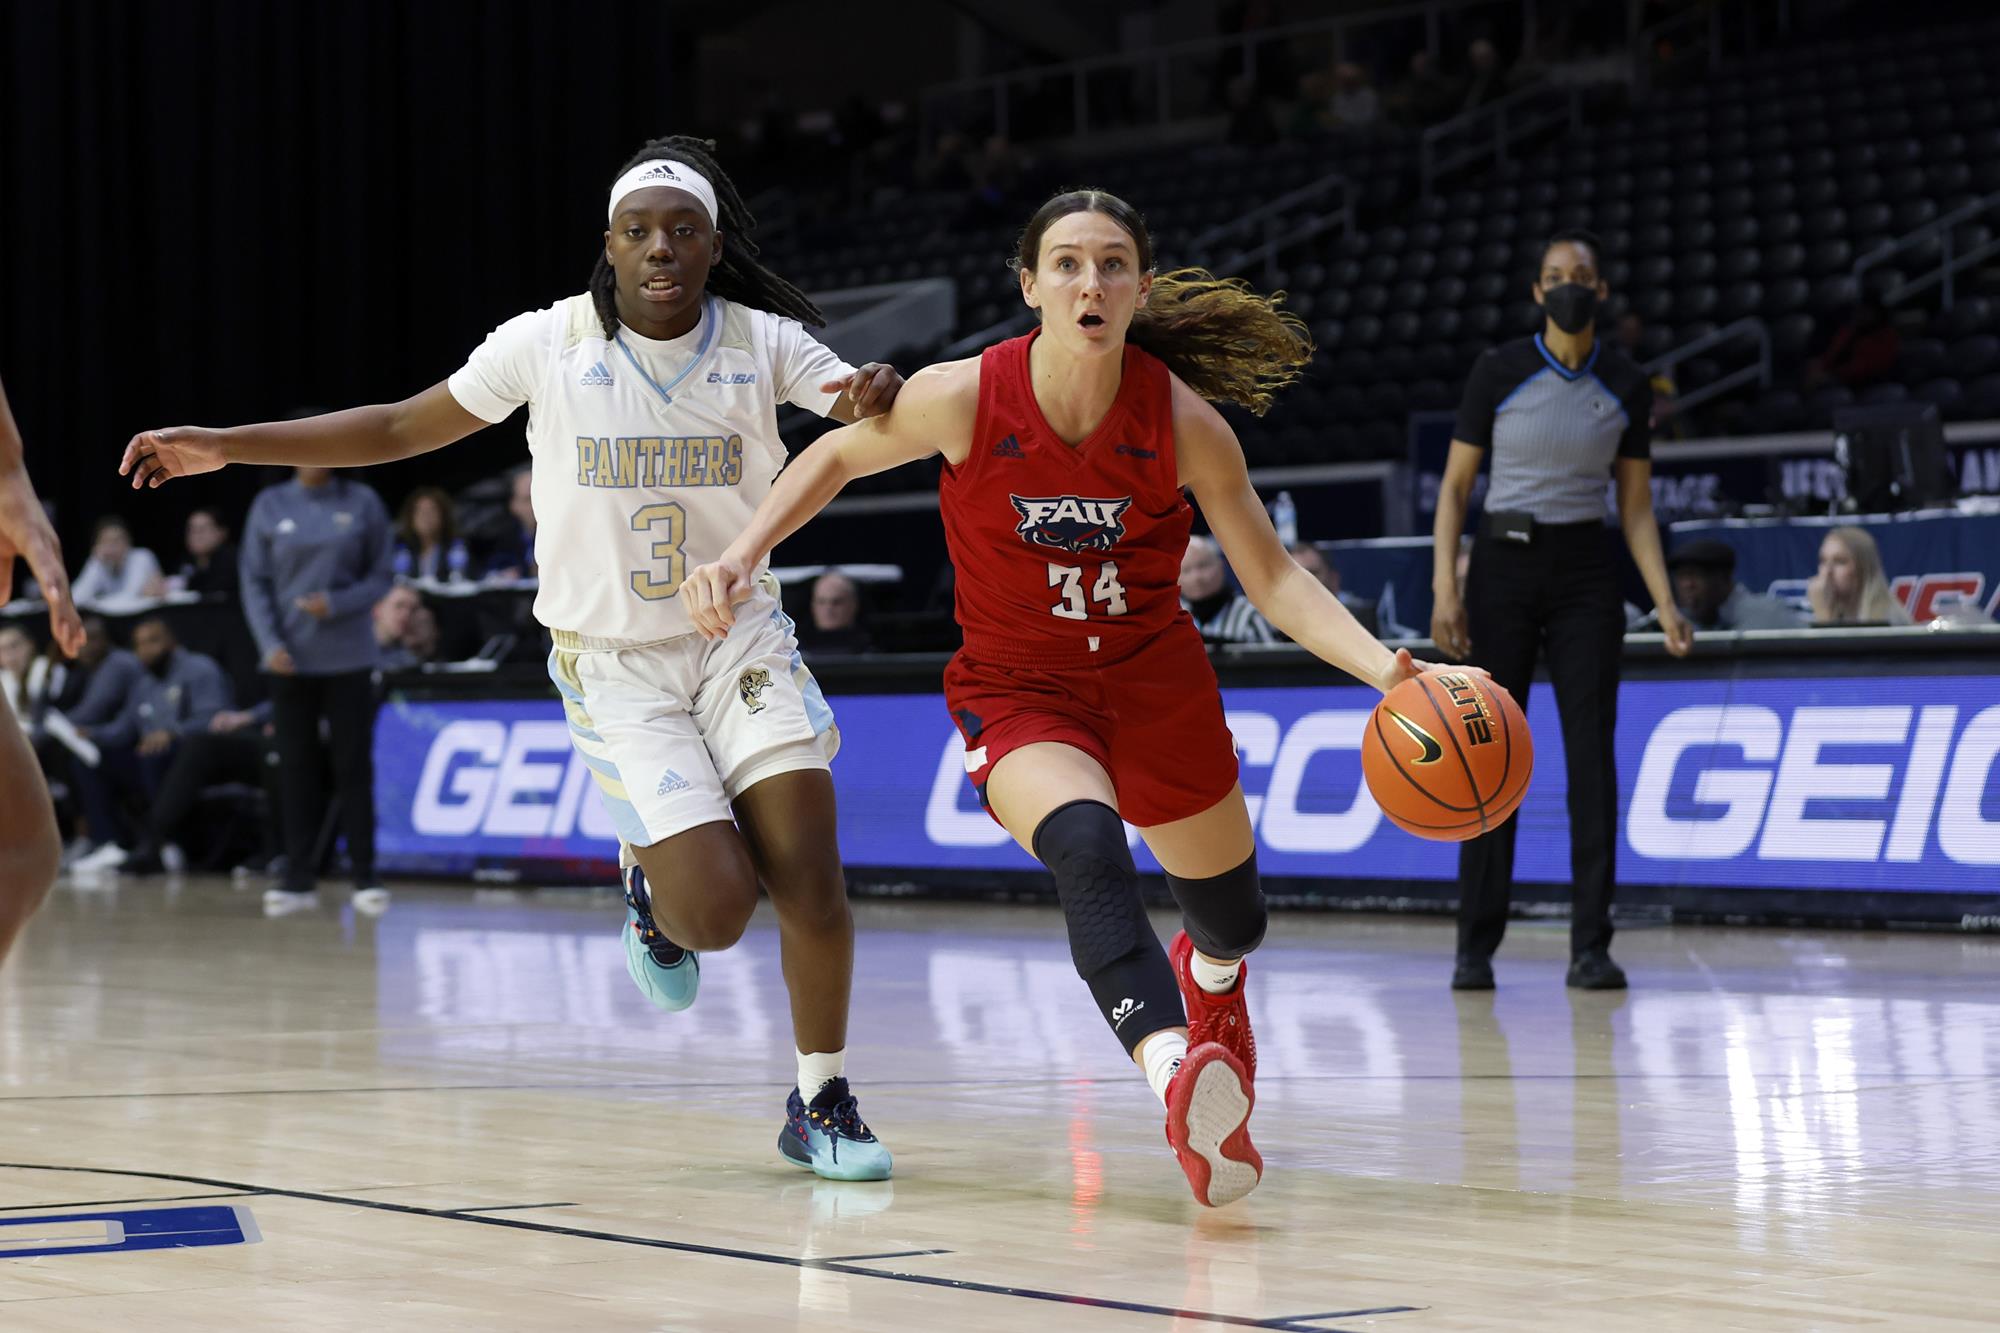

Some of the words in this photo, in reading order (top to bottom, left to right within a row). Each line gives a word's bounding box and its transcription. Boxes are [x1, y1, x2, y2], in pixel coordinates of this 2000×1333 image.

[638, 172, 682, 183] adidas
[580, 376, 615, 387] adidas
[576, 434, 743, 488] PANTHERS
[1018, 498, 1124, 531] FAU
[631, 501, 687, 601] 3
[1047, 560, 1128, 621] 34
[1434, 672, 1493, 746] ELITE
[657, 780, 690, 796] adidas
